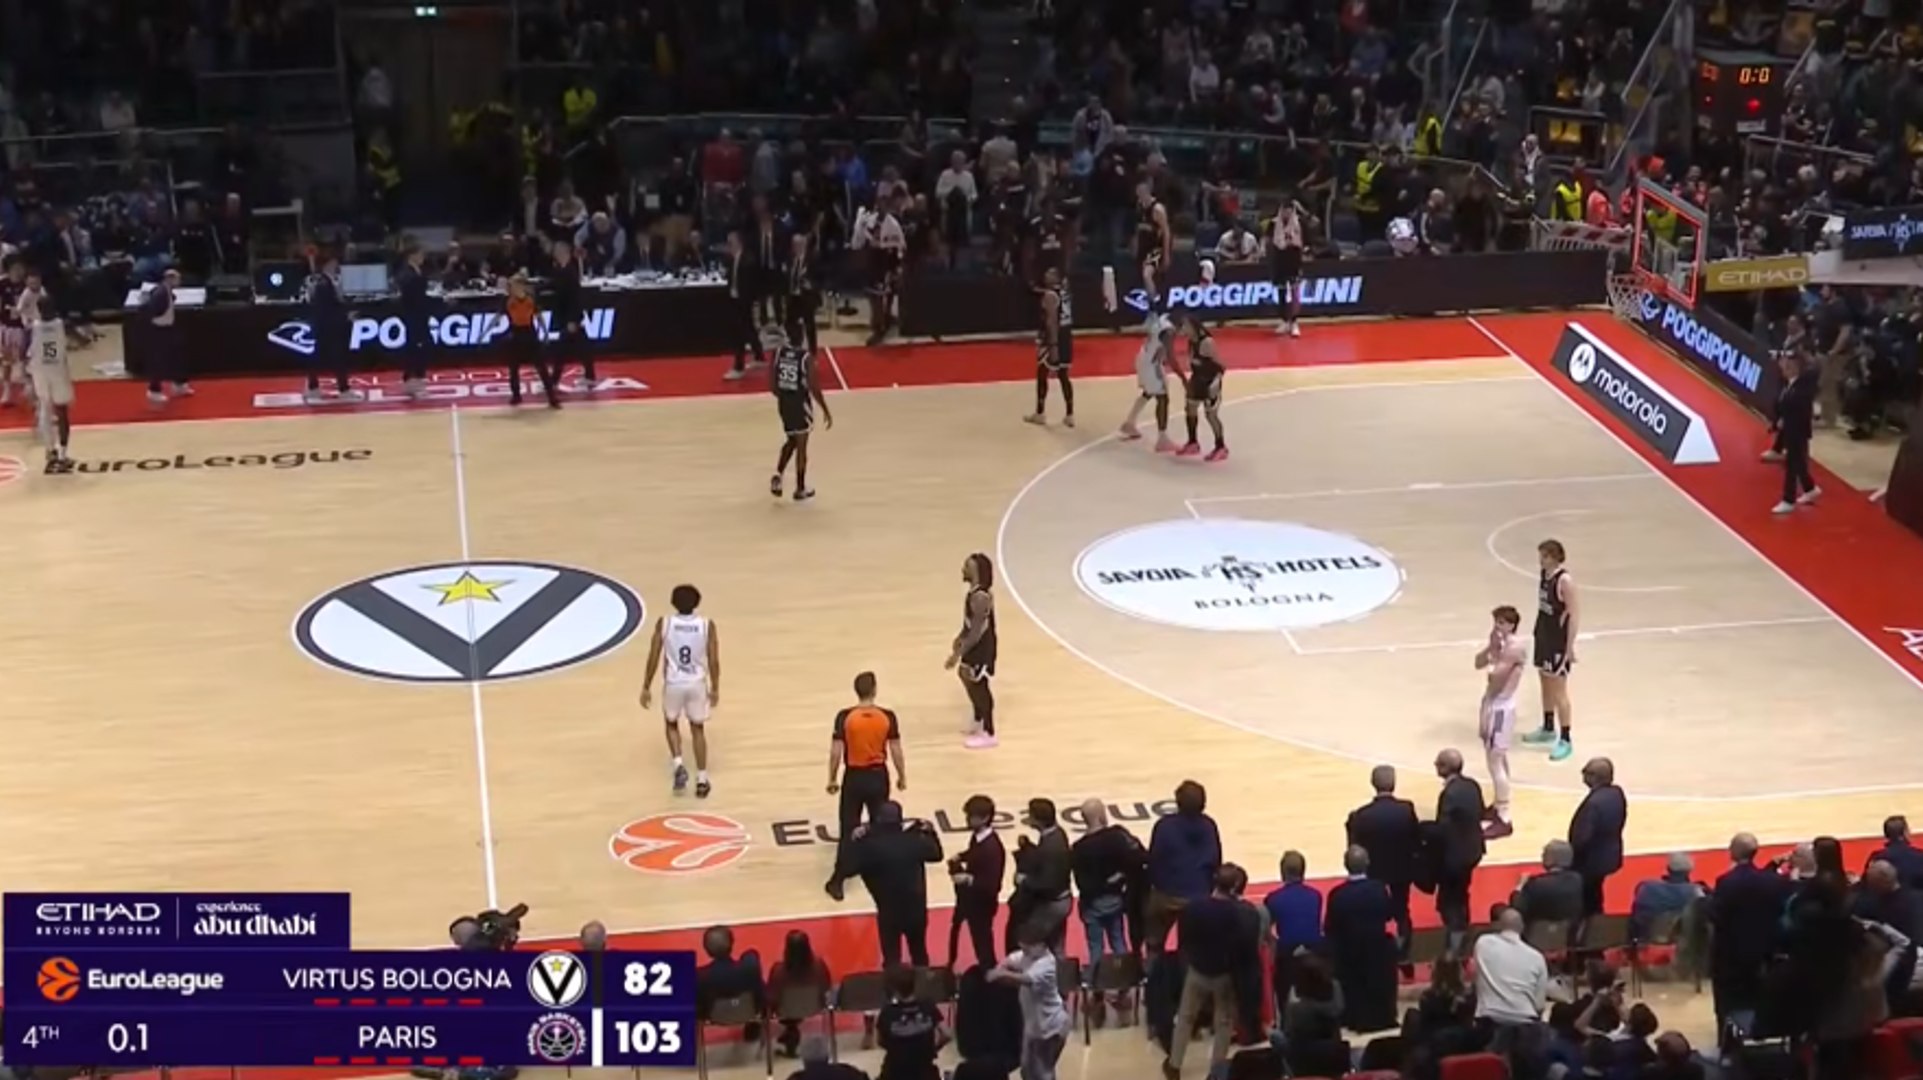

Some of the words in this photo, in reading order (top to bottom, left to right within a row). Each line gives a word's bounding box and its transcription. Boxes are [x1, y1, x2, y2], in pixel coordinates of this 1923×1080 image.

[1718, 269, 1807, 285] ETIHAD
[1662, 303, 1762, 393] POGGIPOLINI
[1593, 368, 1667, 436] motorola
[1276, 555, 1382, 574] HOTELS
[1194, 592, 1333, 609] BOLOGNA
[679, 645, 691, 665] 8
